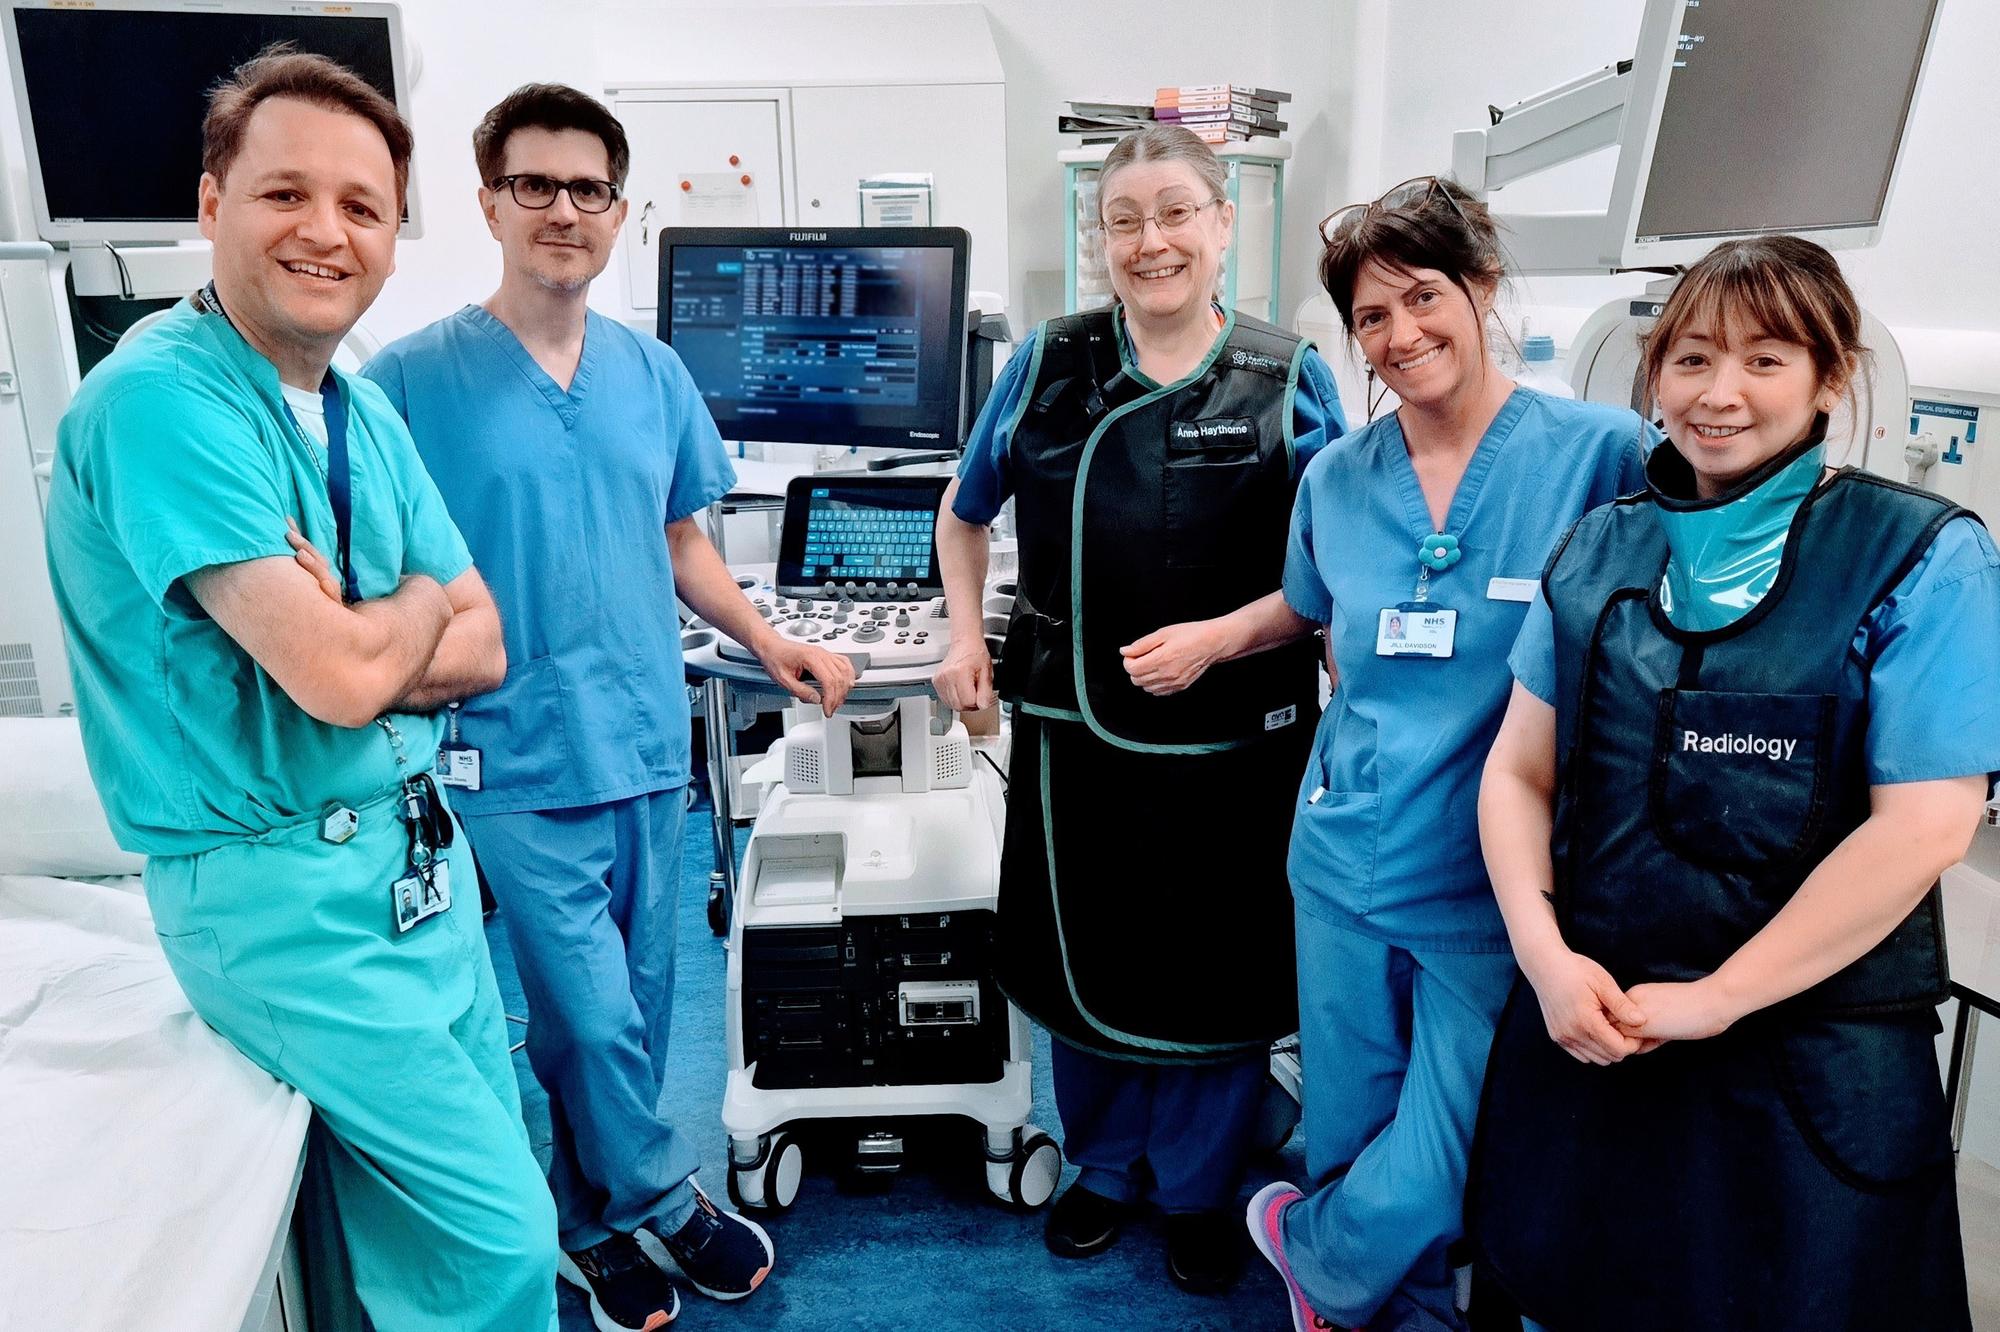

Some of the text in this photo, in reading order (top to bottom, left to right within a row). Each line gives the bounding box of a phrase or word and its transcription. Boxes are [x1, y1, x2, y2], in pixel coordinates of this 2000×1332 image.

[789, 232, 827, 241] FUJIFILM
[1914, 404, 1977, 417] MEDICAL EQUIPMENT ONLY
[1177, 425, 1248, 438] Anne Haythorne
[1683, 730, 1797, 761] Radiology
